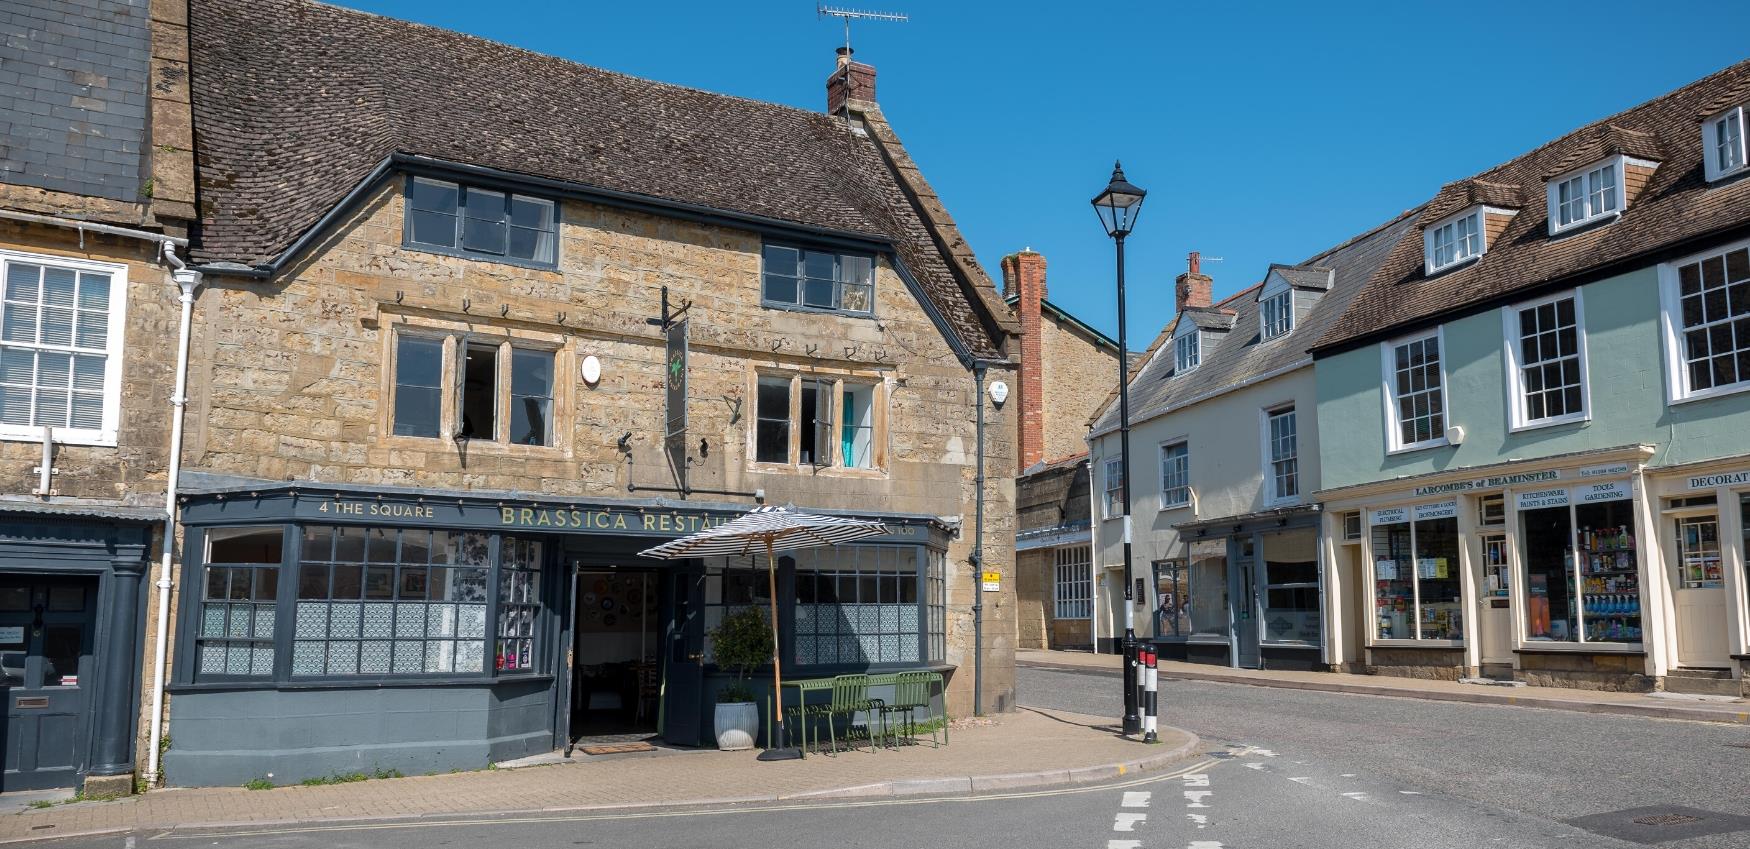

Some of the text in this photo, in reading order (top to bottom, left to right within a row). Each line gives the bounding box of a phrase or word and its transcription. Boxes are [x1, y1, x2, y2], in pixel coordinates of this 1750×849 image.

[1415, 470, 1558, 496] LARCOMBE'S of BEAMINSTER
[1690, 472, 1749, 488] DECORAT
[1522, 489, 1565, 500] KITCHENWARE
[1593, 483, 1614, 492] TOOLS
[1520, 500, 1541, 508] PAINTS
[1547, 496, 1569, 506] STAINS
[1584, 490, 1624, 501] GARDENING
[319, 501, 434, 518] 4 THE SQUARE
[501, 507, 628, 530] BRASSICA
